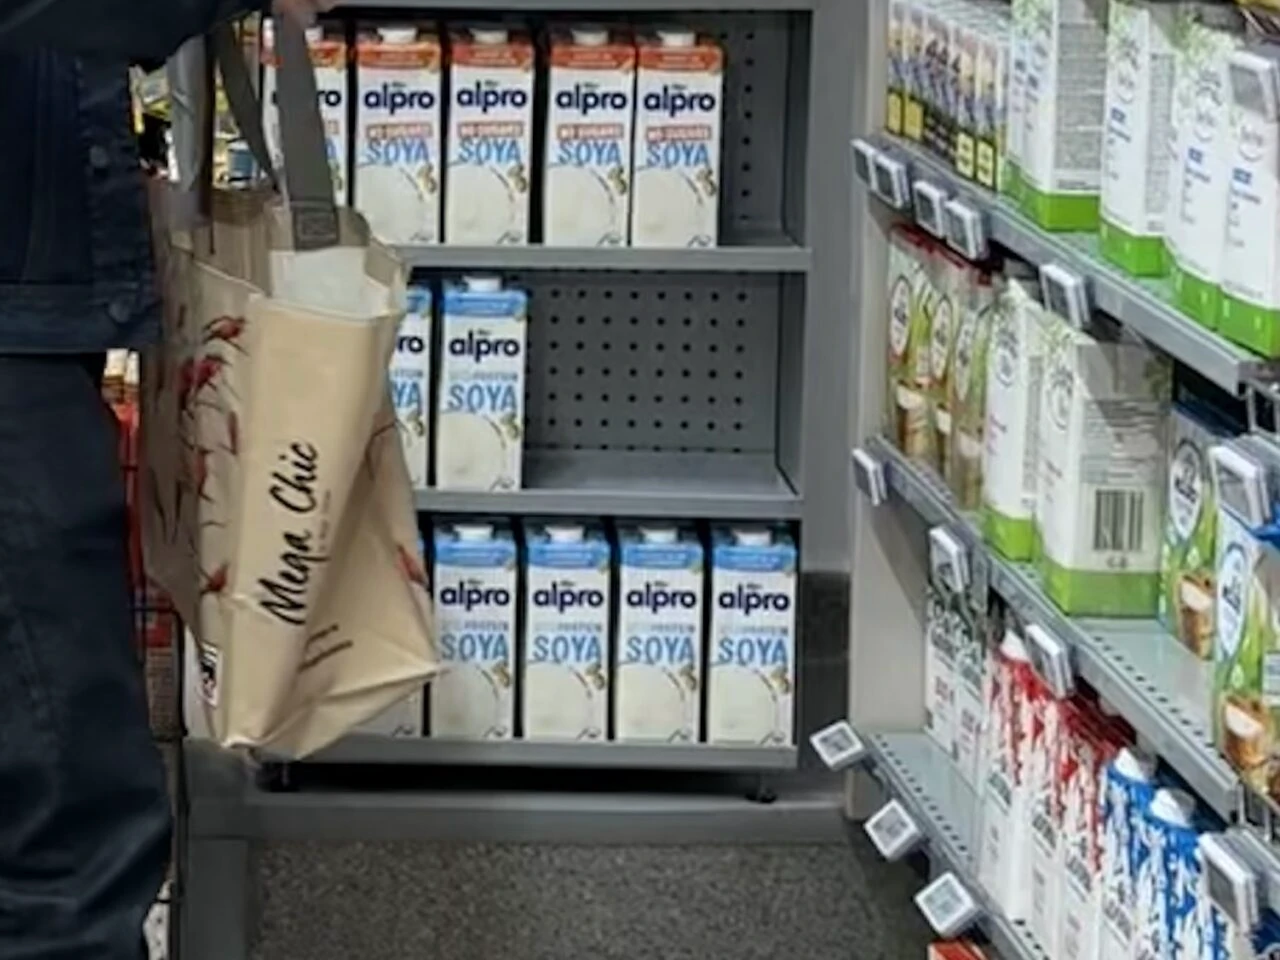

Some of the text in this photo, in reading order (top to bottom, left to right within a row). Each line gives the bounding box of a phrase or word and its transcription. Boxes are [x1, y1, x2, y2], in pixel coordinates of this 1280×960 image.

[364, 82, 435, 115] alpro
[457, 81, 528, 113] alpro
[555, 82, 627, 116] alpro
[643, 84, 716, 117] alpro
[366, 138, 430, 162] SOYA
[459, 138, 520, 163] SOYA
[557, 141, 621, 166] SOYA
[645, 142, 711, 167] SOYA
[449, 330, 520, 363] alpro
[393, 381, 422, 410] YA
[448, 383, 518, 412] SOYA
[258, 442, 331, 627] Mega Chic
[440, 580, 510, 612] alpro
[533, 581, 604, 613] alpro
[626, 581, 697, 614] alpro
[718, 583, 790, 616] alpro
[441, 633, 509, 661] SOYA
[533, 635, 601, 662] SOYA
[626, 636, 695, 664] SOYA
[718, 637, 789, 665] SOYA
